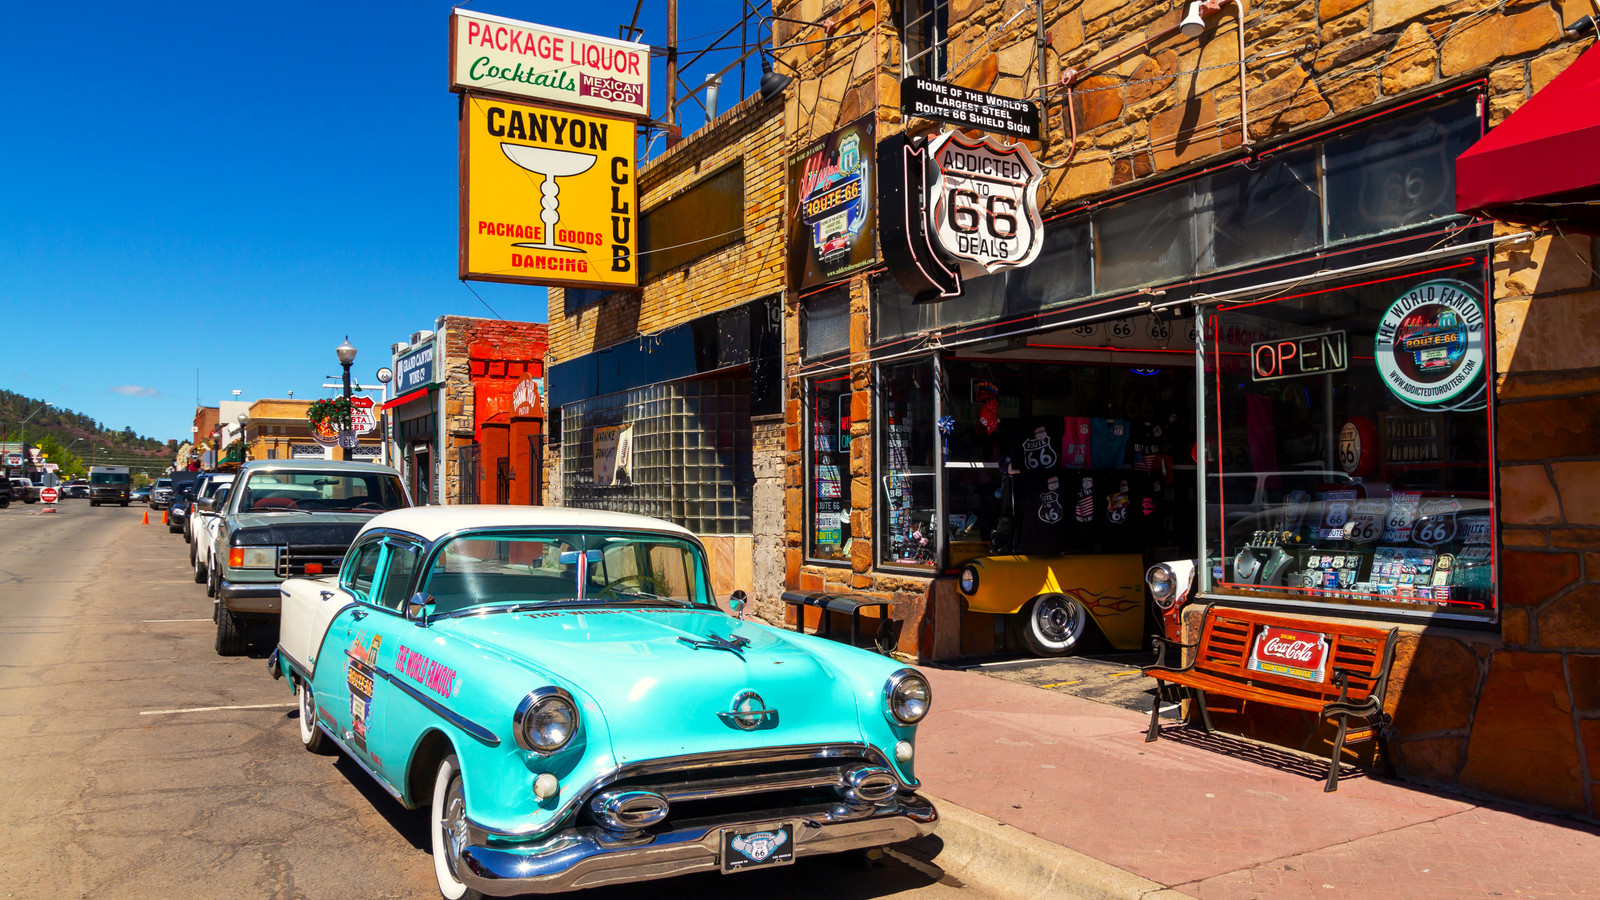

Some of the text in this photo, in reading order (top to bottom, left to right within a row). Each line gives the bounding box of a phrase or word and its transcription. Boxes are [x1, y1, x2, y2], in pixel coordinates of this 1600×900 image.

[468, 21, 640, 76] PACKAGE LIQUOR
[469, 56, 576, 92] Cocktails
[583, 75, 641, 95] MEXICAN
[590, 87, 636, 103] FOOD
[917, 79, 948, 95] HOME
[950, 87, 963, 97] OF
[965, 91, 983, 103] THE
[936, 94, 1012, 119] LARGEST STEEL
[915, 101, 1031, 134] ROUTE 66 SHIELD SIGN
[487, 107, 608, 151] CANYON
[843, 153, 855, 170] 66
[943, 149, 1022, 180] ADDICTED
[806, 181, 859, 217] ROUTE 66
[976, 182, 990, 197] TO
[611, 156, 631, 272] CLUB
[950, 188, 1018, 240] 66
[478, 221, 603, 246] PACKAGE GOODS
[958, 236, 1009, 259] DEALS
[511, 253, 588, 273] DANCING
[1377, 286, 1485, 346] THE WORLD FAMOUS
[1113, 323, 1131, 336] 66
[1151, 326, 1169, 338] 66
[1406, 333, 1457, 348] ROUTE 66
[403, 355, 416, 373] GRAND
[1255, 334, 1343, 377] OPEN
[1388, 359, 1477, 398] WWW.ADDICTEDTOROUTE66.COM
[1027, 447, 1053, 470] 66
[1341, 446, 1354, 464] 66
[833, 501, 840, 510] 66
[1327, 491, 1356, 501] HISTORIC
[1423, 502, 1456, 514] HISTORIC
[1330, 515, 1343, 524] 66
[1351, 521, 1374, 538] 66
[1390, 516, 1405, 527] 66
[1323, 529, 1344, 537] ROUTE
[1419, 523, 1446, 541] 66
[1280, 633, 1296, 641] DRINK
[1263, 637, 1316, 662] Coca-Cola
[395, 644, 411, 673] THE
[405, 650, 430, 684] WORLD
[425, 660, 457, 699] FAMOUS
[1288, 667, 1312, 678] SERVICE
[754, 849, 765, 858] 66
